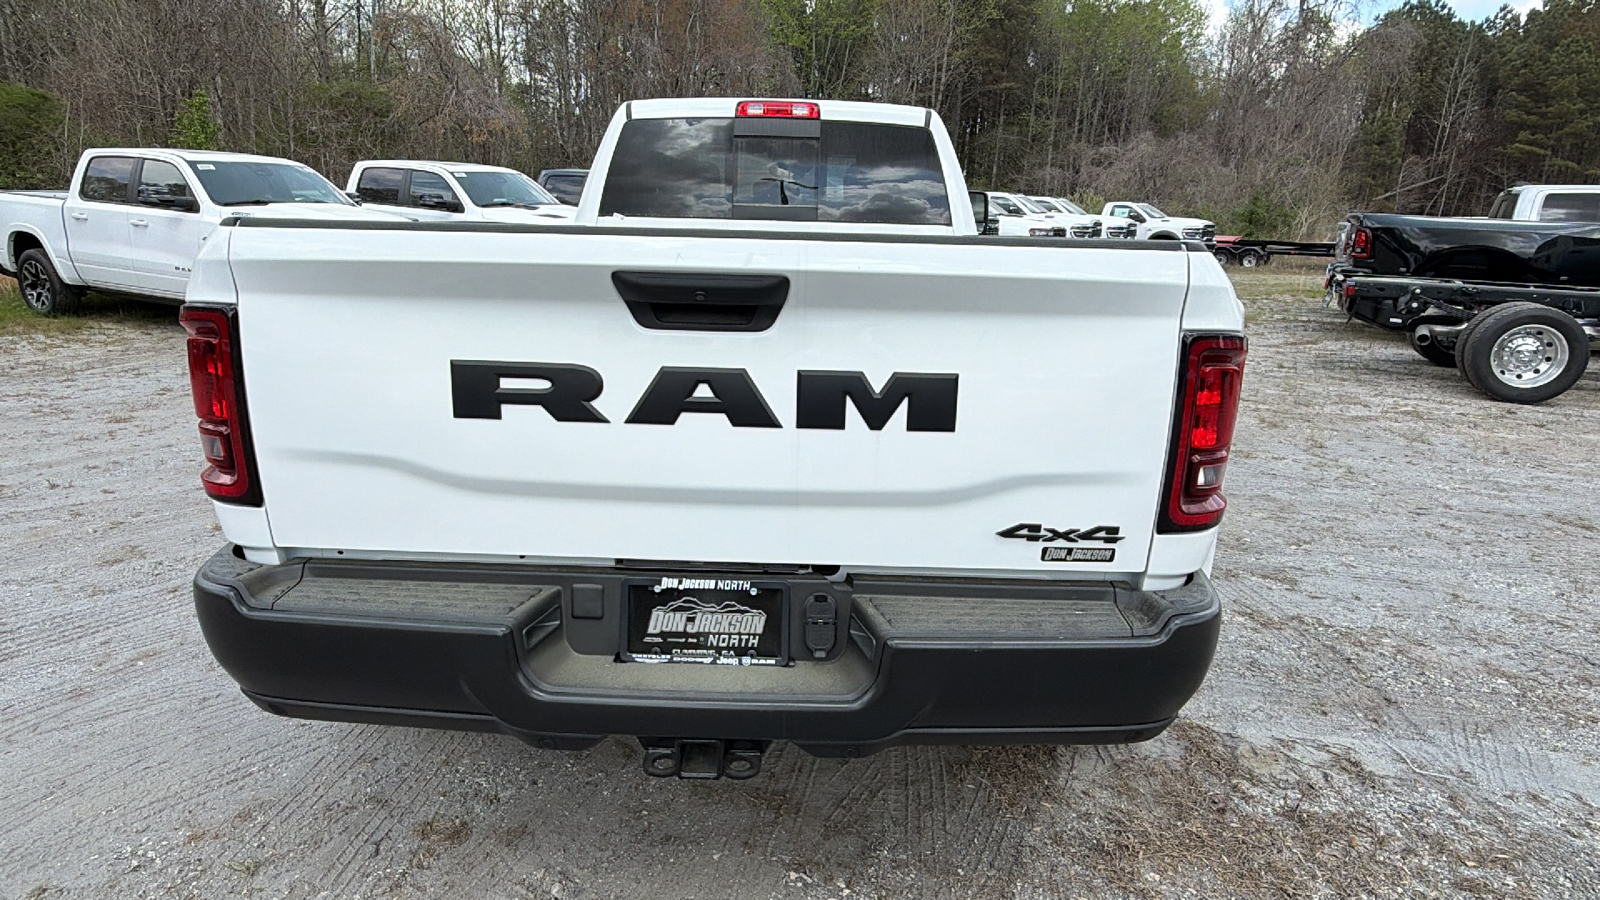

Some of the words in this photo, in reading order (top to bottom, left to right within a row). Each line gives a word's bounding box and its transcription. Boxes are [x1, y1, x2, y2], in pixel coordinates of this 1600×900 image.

[450, 358, 959, 433] RAM
[995, 523, 1126, 544] 4x4
[1066, 548, 1113, 561] JACKSON
[717, 580, 750, 591] NORTH
[647, 611, 688, 634] DON
[687, 612, 767, 635] JACKSON
[708, 634, 759, 647] NORTH
[717, 656, 739, 666] Jeep
